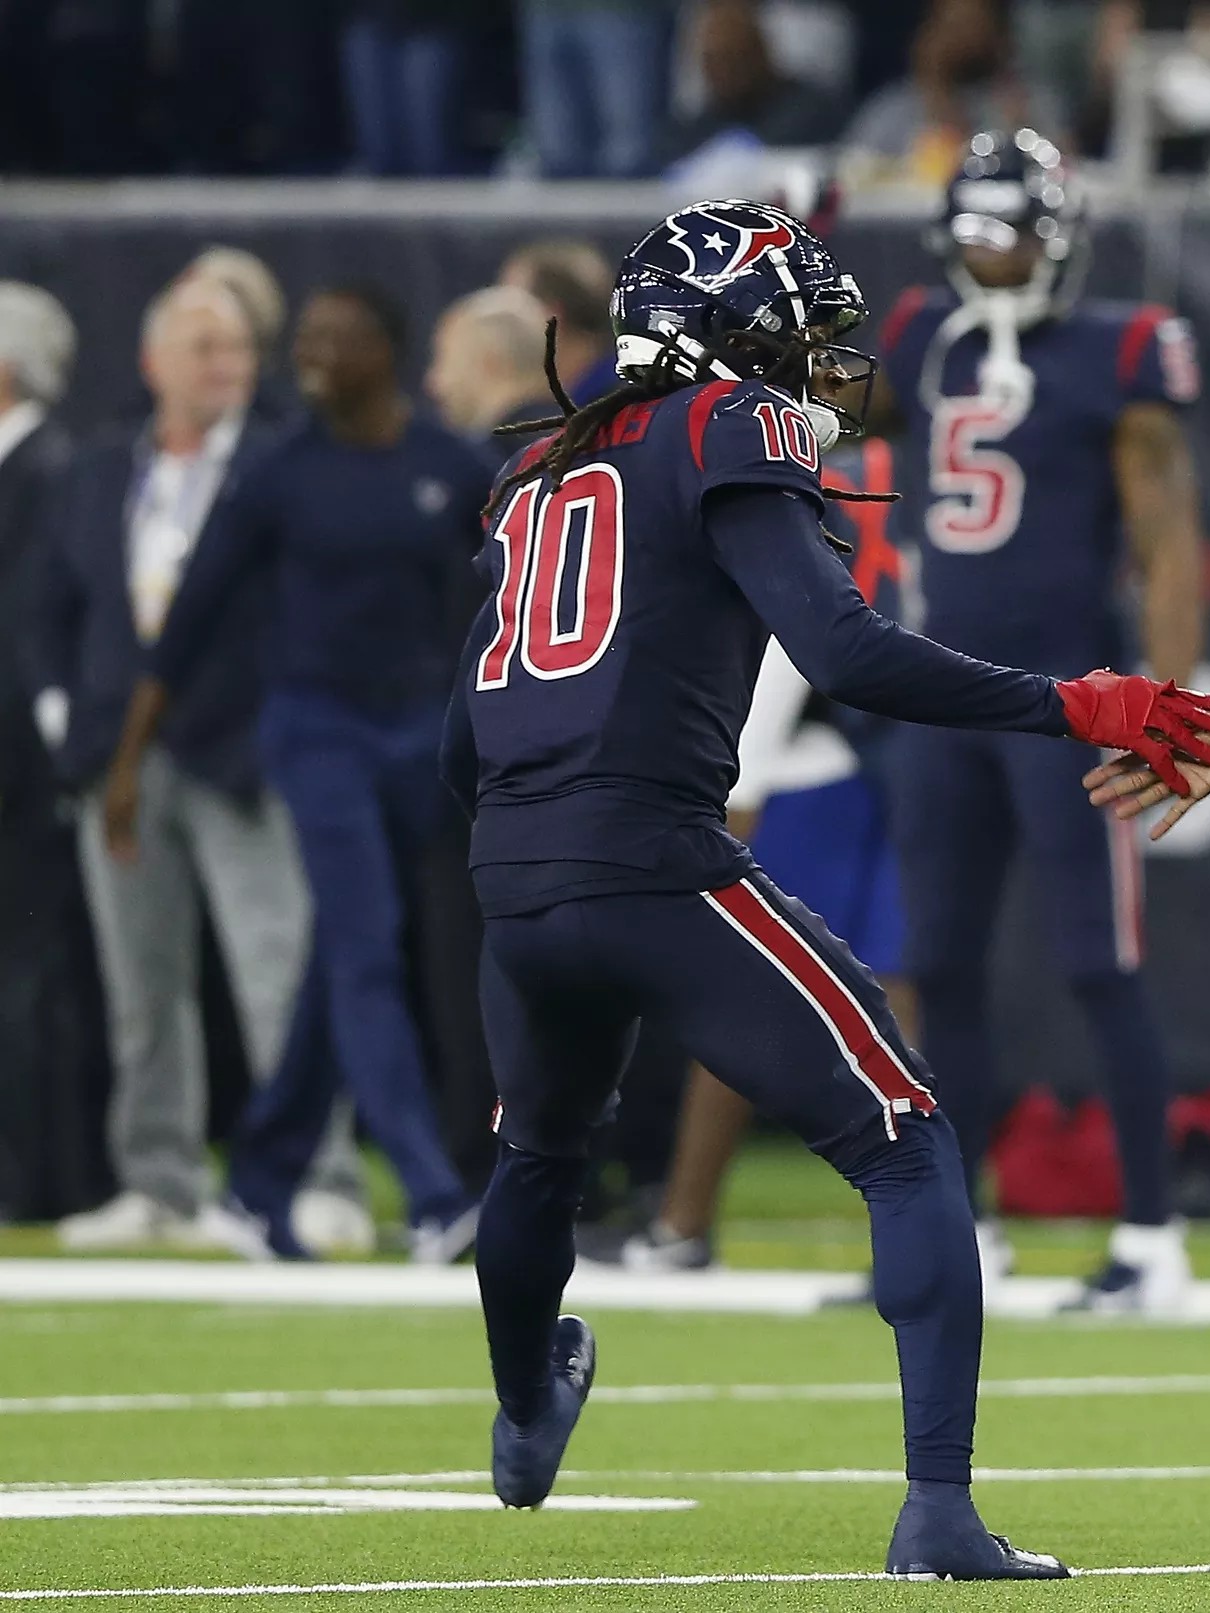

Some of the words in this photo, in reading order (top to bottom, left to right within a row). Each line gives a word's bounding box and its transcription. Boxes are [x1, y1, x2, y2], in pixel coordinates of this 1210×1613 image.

[752, 402, 819, 473] 10
[925, 398, 1026, 555] 5
[475, 462, 624, 692] 10
